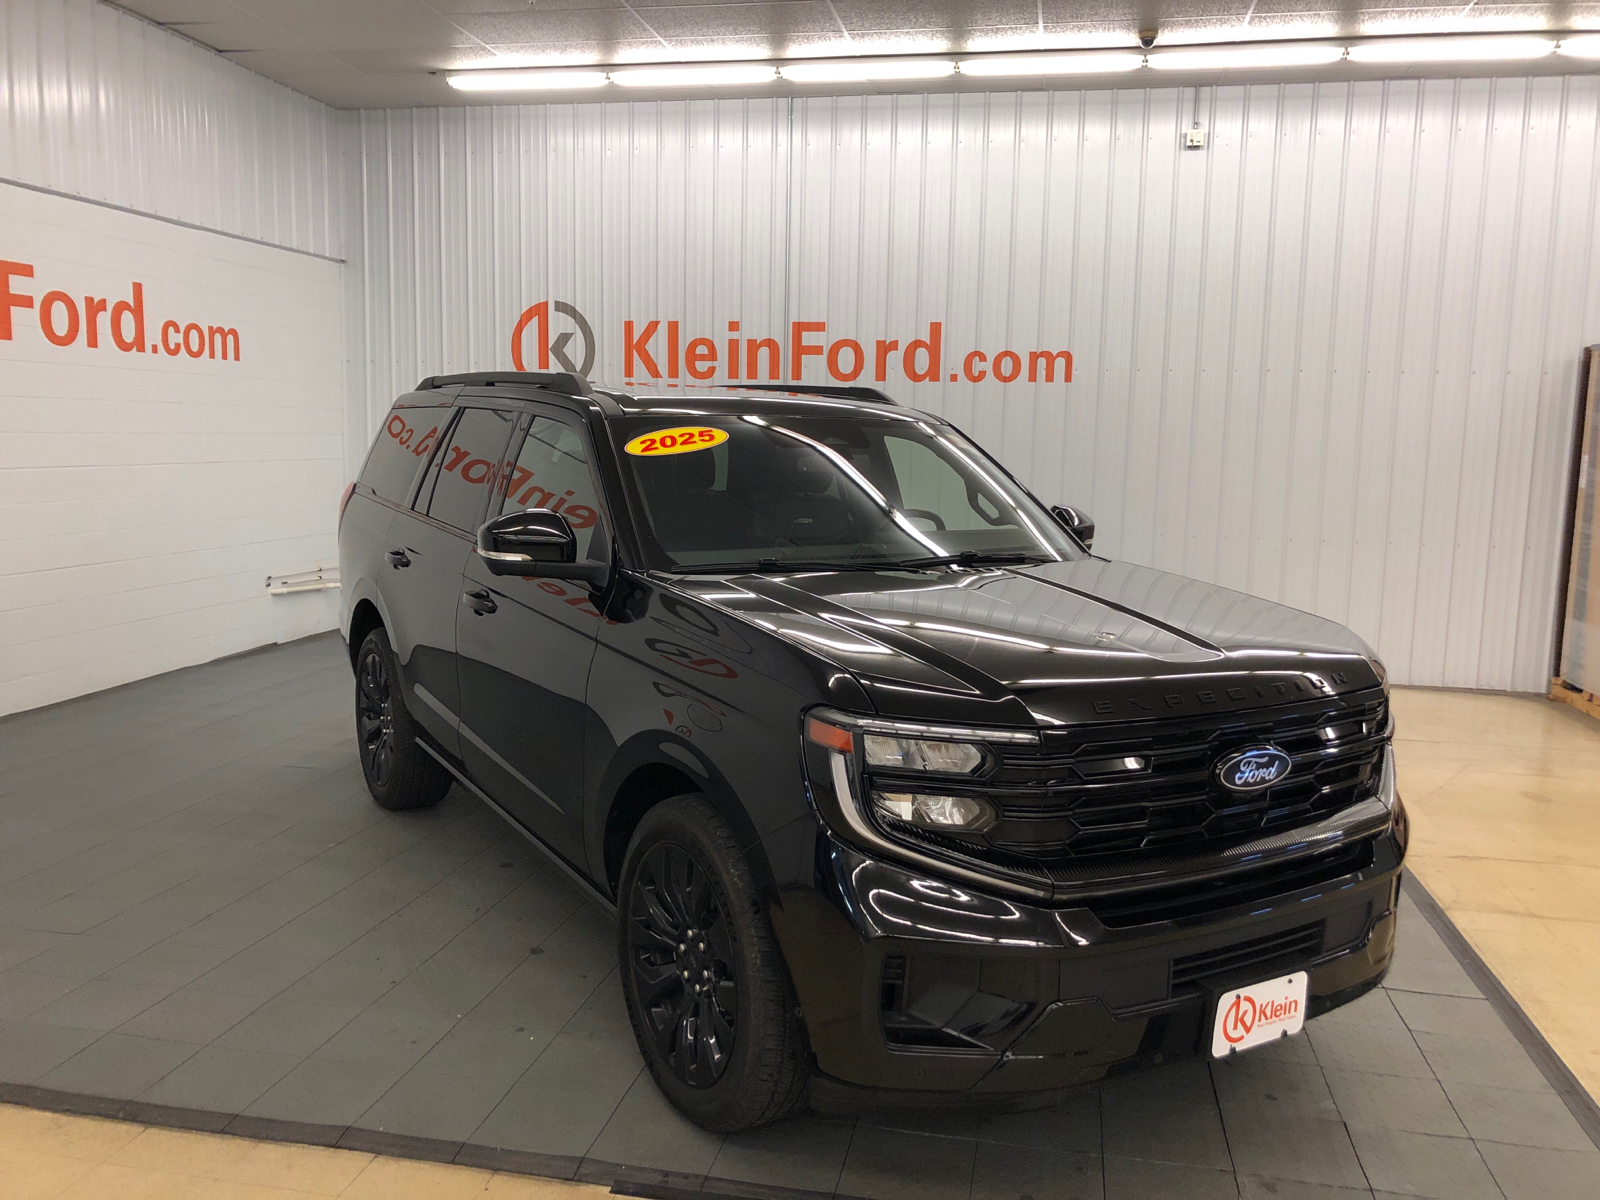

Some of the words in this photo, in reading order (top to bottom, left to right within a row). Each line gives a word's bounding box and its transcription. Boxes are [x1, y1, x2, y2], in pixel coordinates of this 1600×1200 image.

[0, 259, 241, 362] Ford.com
[623, 320, 1074, 384] KleinFord.com
[639, 427, 717, 454] 2025
[1092, 672, 1348, 714] EXPEDITION
[1235, 756, 1280, 785] Ford
[1257, 995, 1299, 1023] Klein
